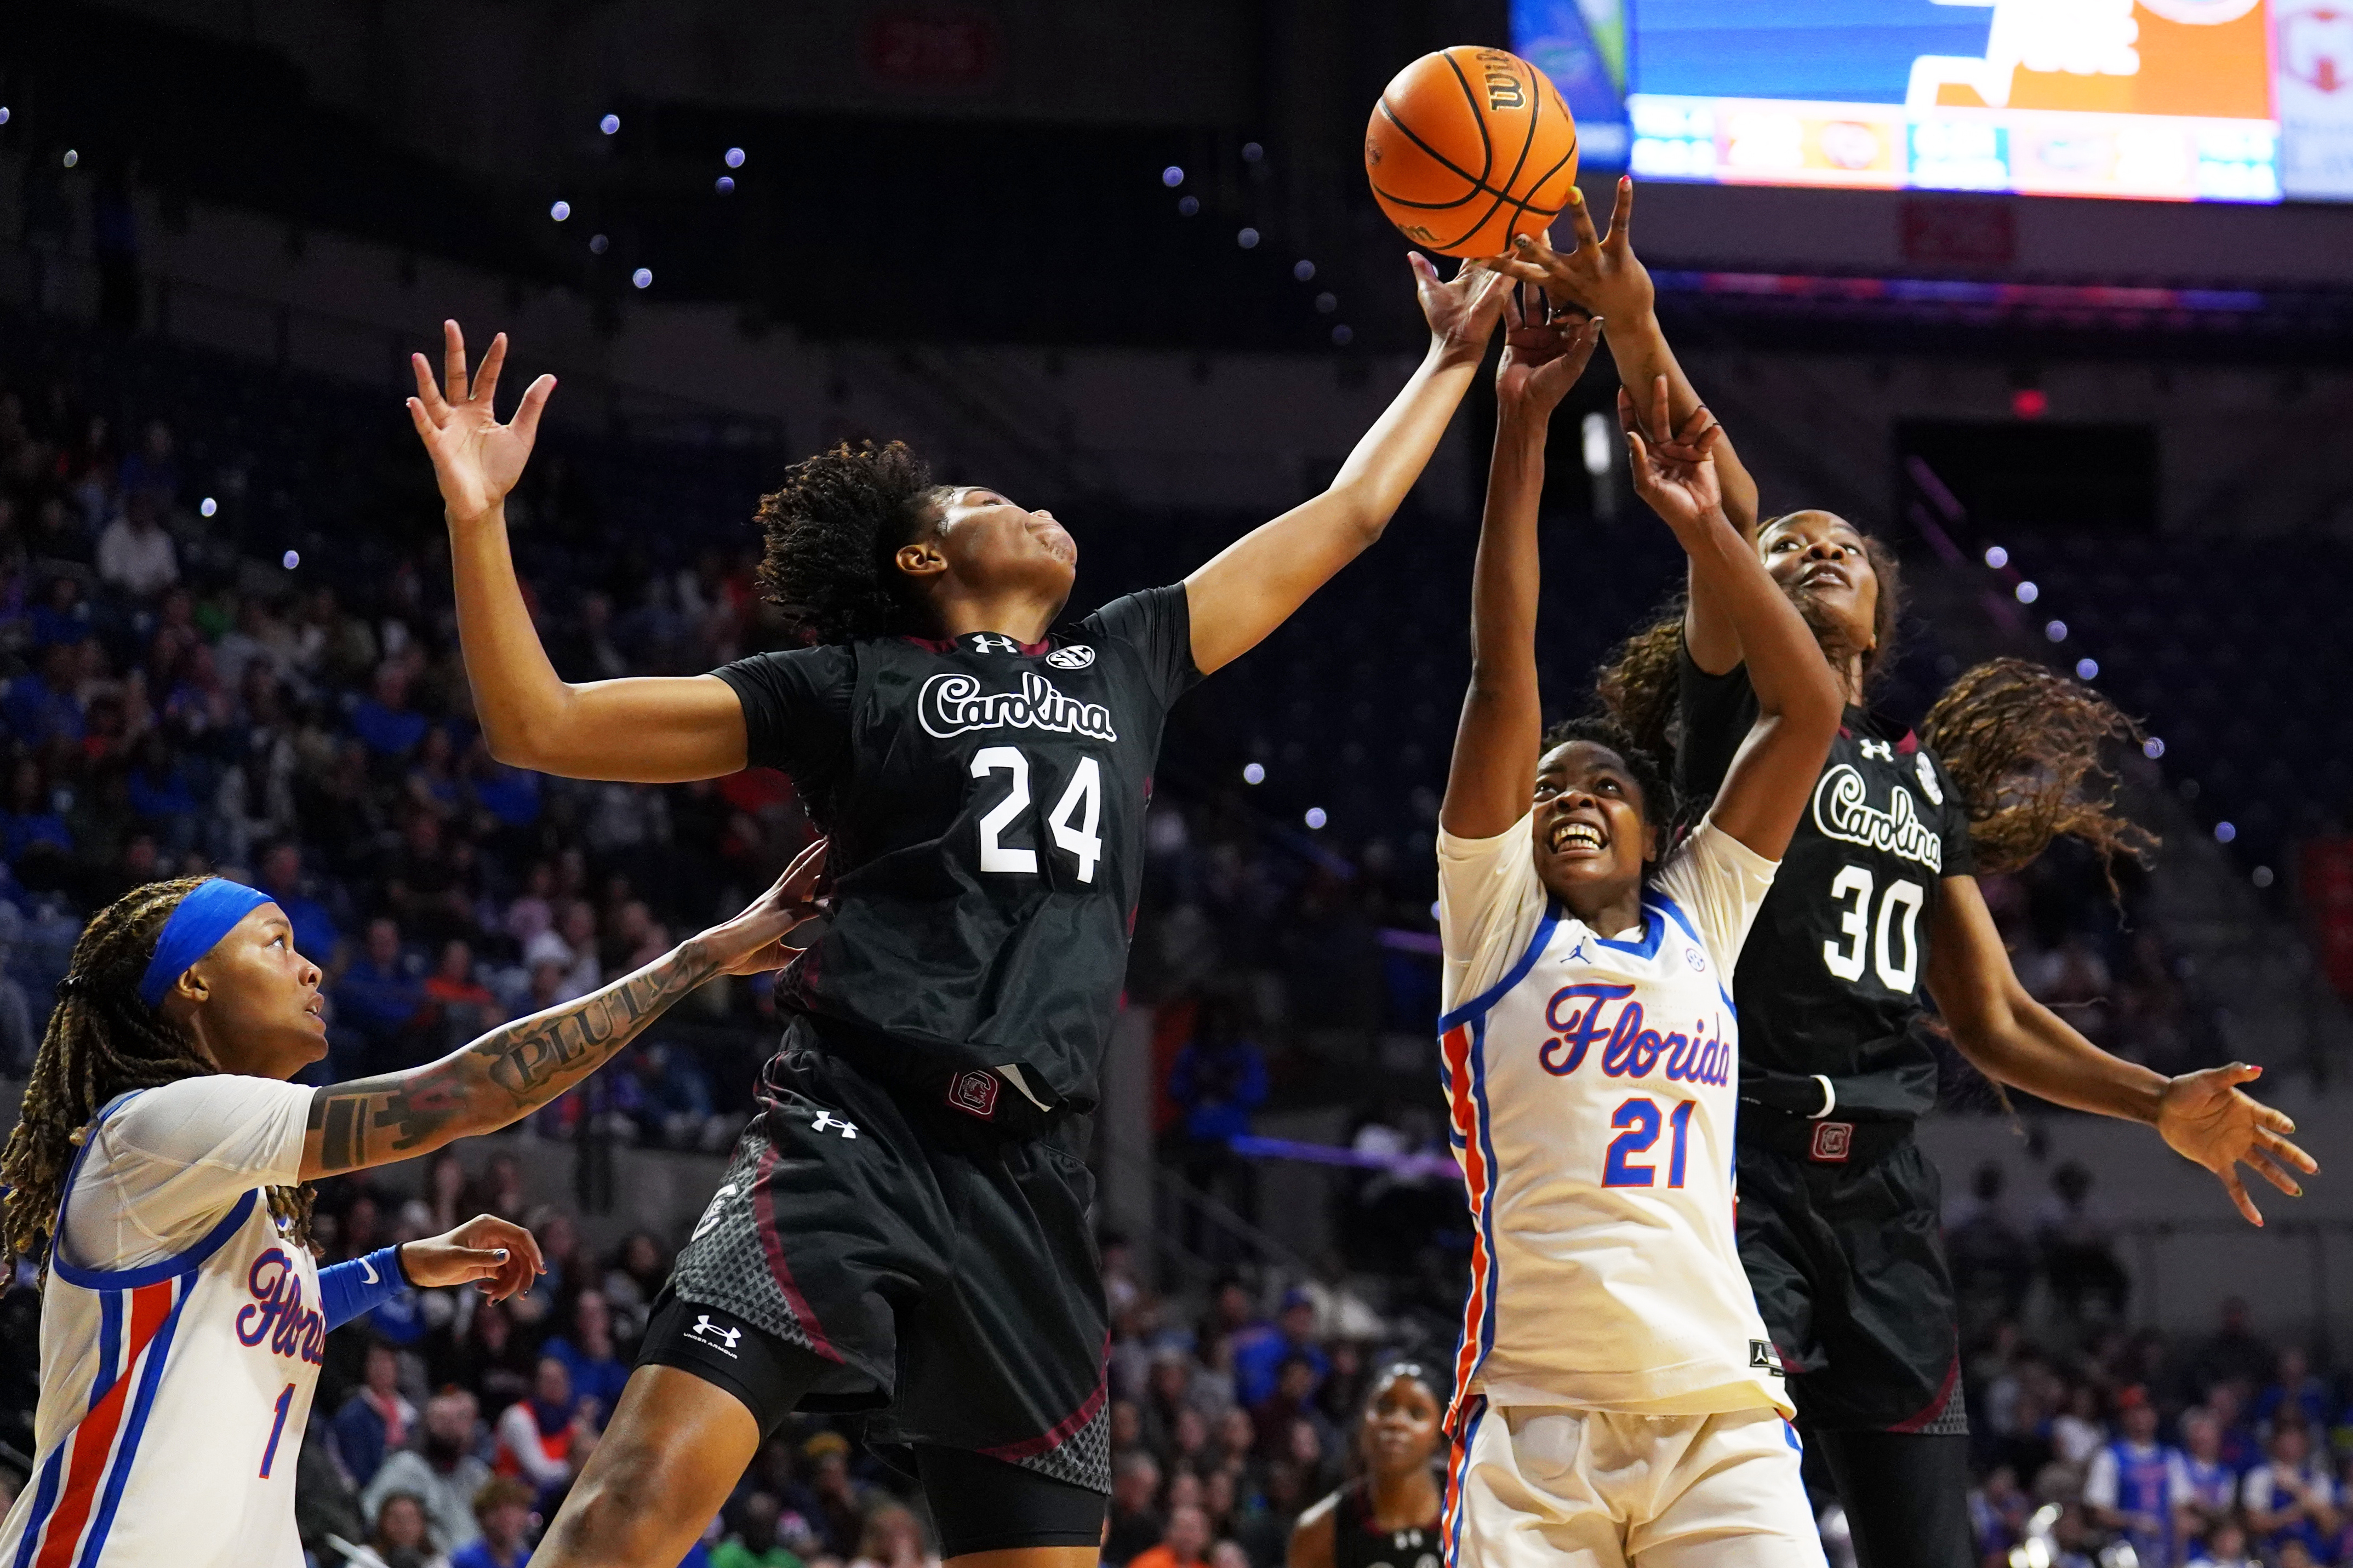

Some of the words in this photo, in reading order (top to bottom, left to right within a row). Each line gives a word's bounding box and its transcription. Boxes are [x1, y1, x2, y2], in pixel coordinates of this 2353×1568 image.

[917, 672, 1117, 742] Carolina
[970, 746, 1102, 884] 24
[1813, 764, 1942, 874] Carolina
[1824, 865, 1923, 994] 30
[1539, 983, 1729, 1087] Florida
[1601, 1098, 1697, 1188] 21
[683, 1332, 707, 1344] UNDER
[707, 1342, 738, 1359] ARMOUR
[259, 1383, 296, 1479] 1
